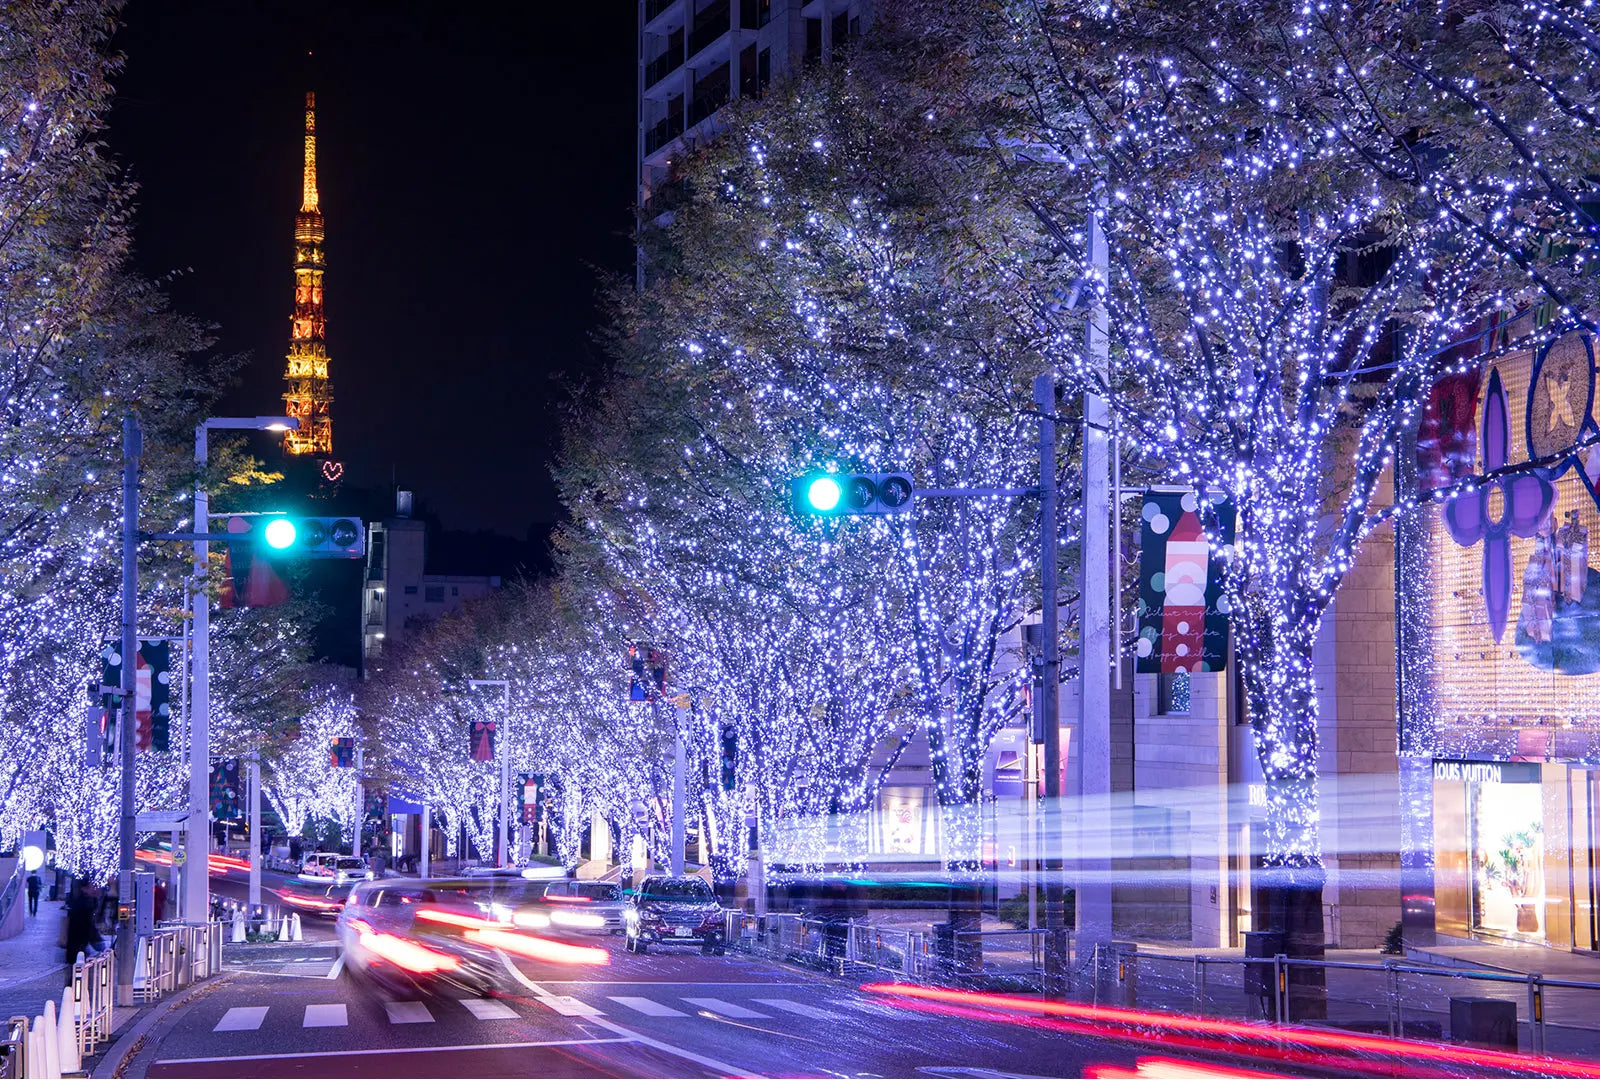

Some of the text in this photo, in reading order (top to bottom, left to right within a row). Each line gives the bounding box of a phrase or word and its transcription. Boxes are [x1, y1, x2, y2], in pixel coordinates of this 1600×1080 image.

[1145, 605, 1180, 618] Silent
[1433, 762, 1502, 783] LOUIS VUITTON
